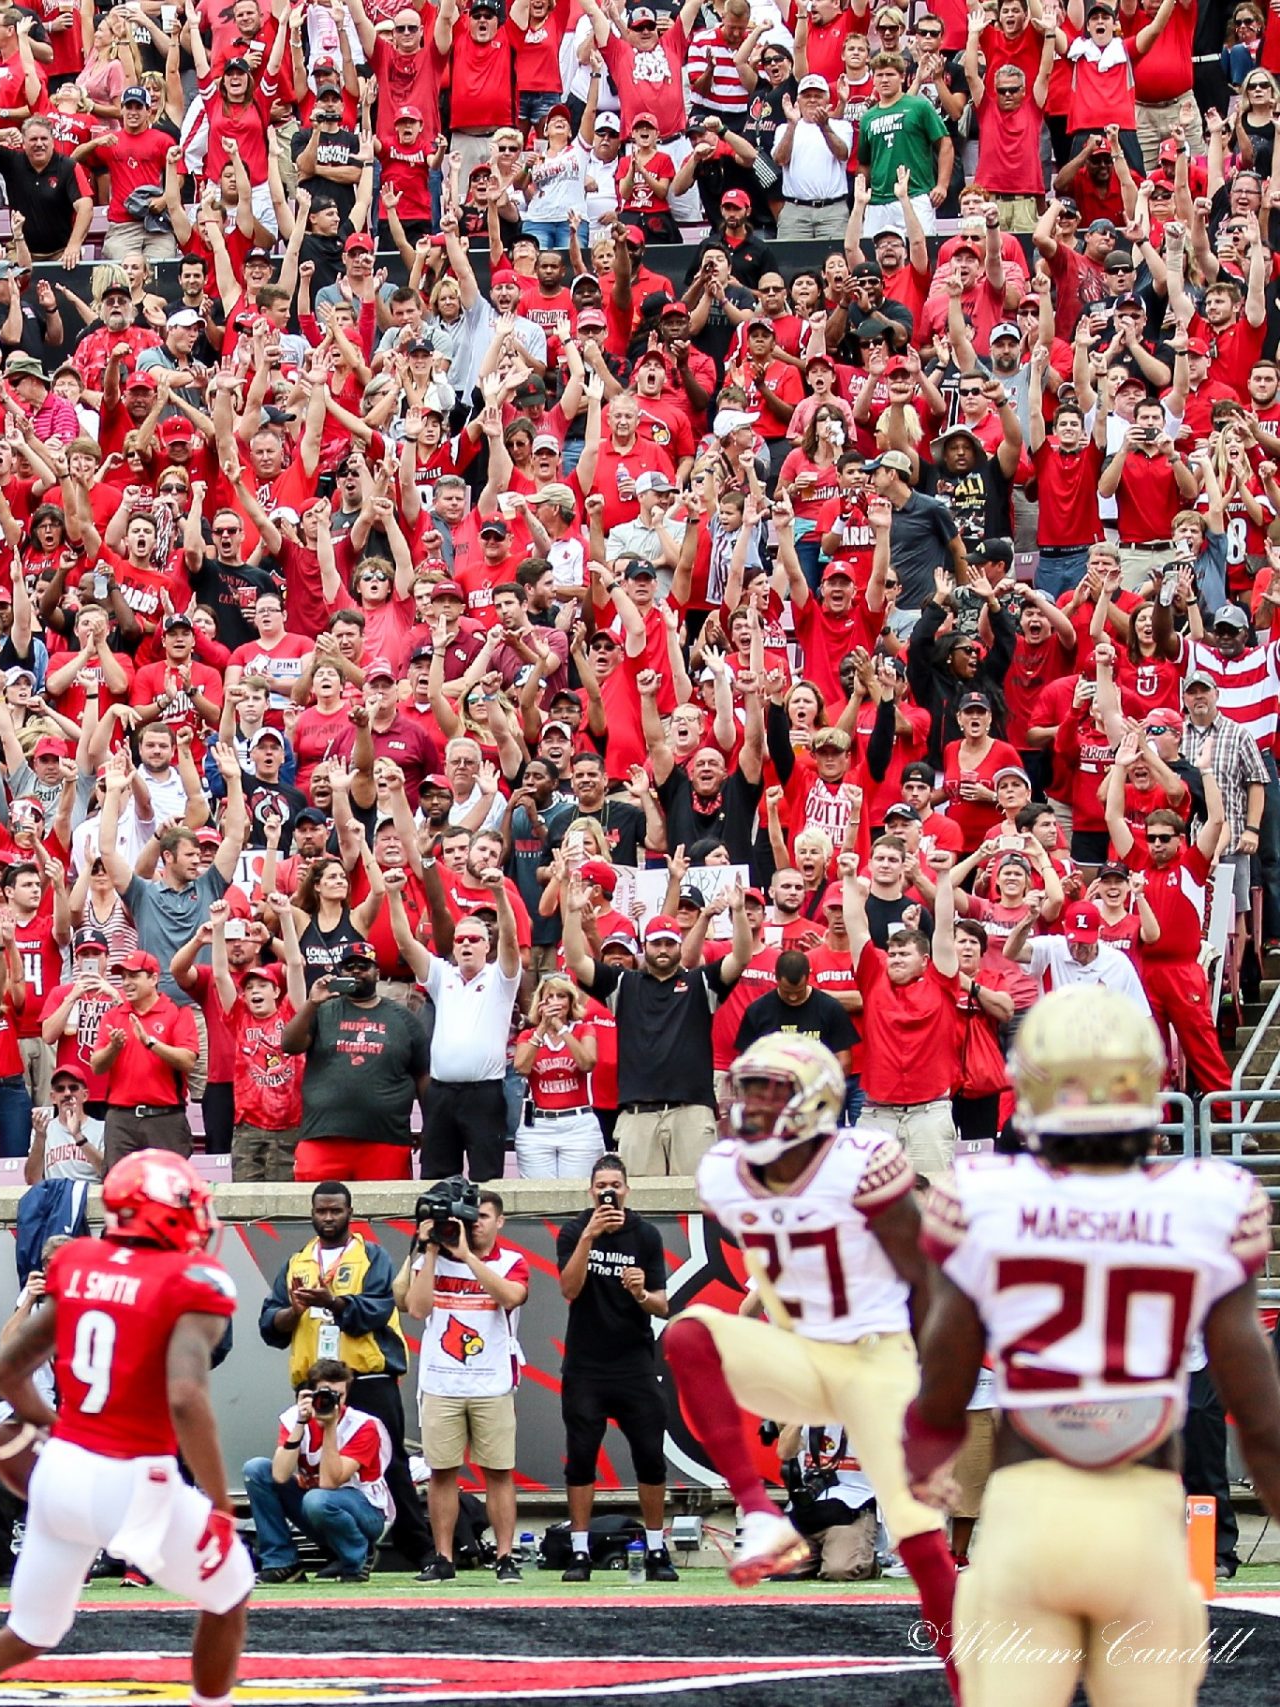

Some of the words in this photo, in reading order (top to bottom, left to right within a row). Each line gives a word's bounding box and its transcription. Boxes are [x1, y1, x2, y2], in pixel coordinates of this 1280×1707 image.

[954, 478, 985, 495] ALI
[842, 527, 877, 546] ARDS
[1226, 519, 1246, 565] 8
[276, 662, 299, 670] PINT
[687, 869, 722, 893] BBY
[1075, 913, 1089, 929] L
[24, 953, 44, 997] 4
[339, 1020, 385, 1034] HUMBLE
[356, 1031, 366, 1043] &
[336, 1040, 384, 1054] HUNGRY
[1019, 1205, 1176, 1249] MARSHALL
[606, 1250, 636, 1265] Miles
[592, 1263, 611, 1276] The
[741, 1226, 848, 1322] 27
[64, 1269, 82, 1299] J.
[87, 1272, 138, 1306] SMITH
[994, 1257, 1199, 1392] 20
[71, 1310, 116, 1414] 9
